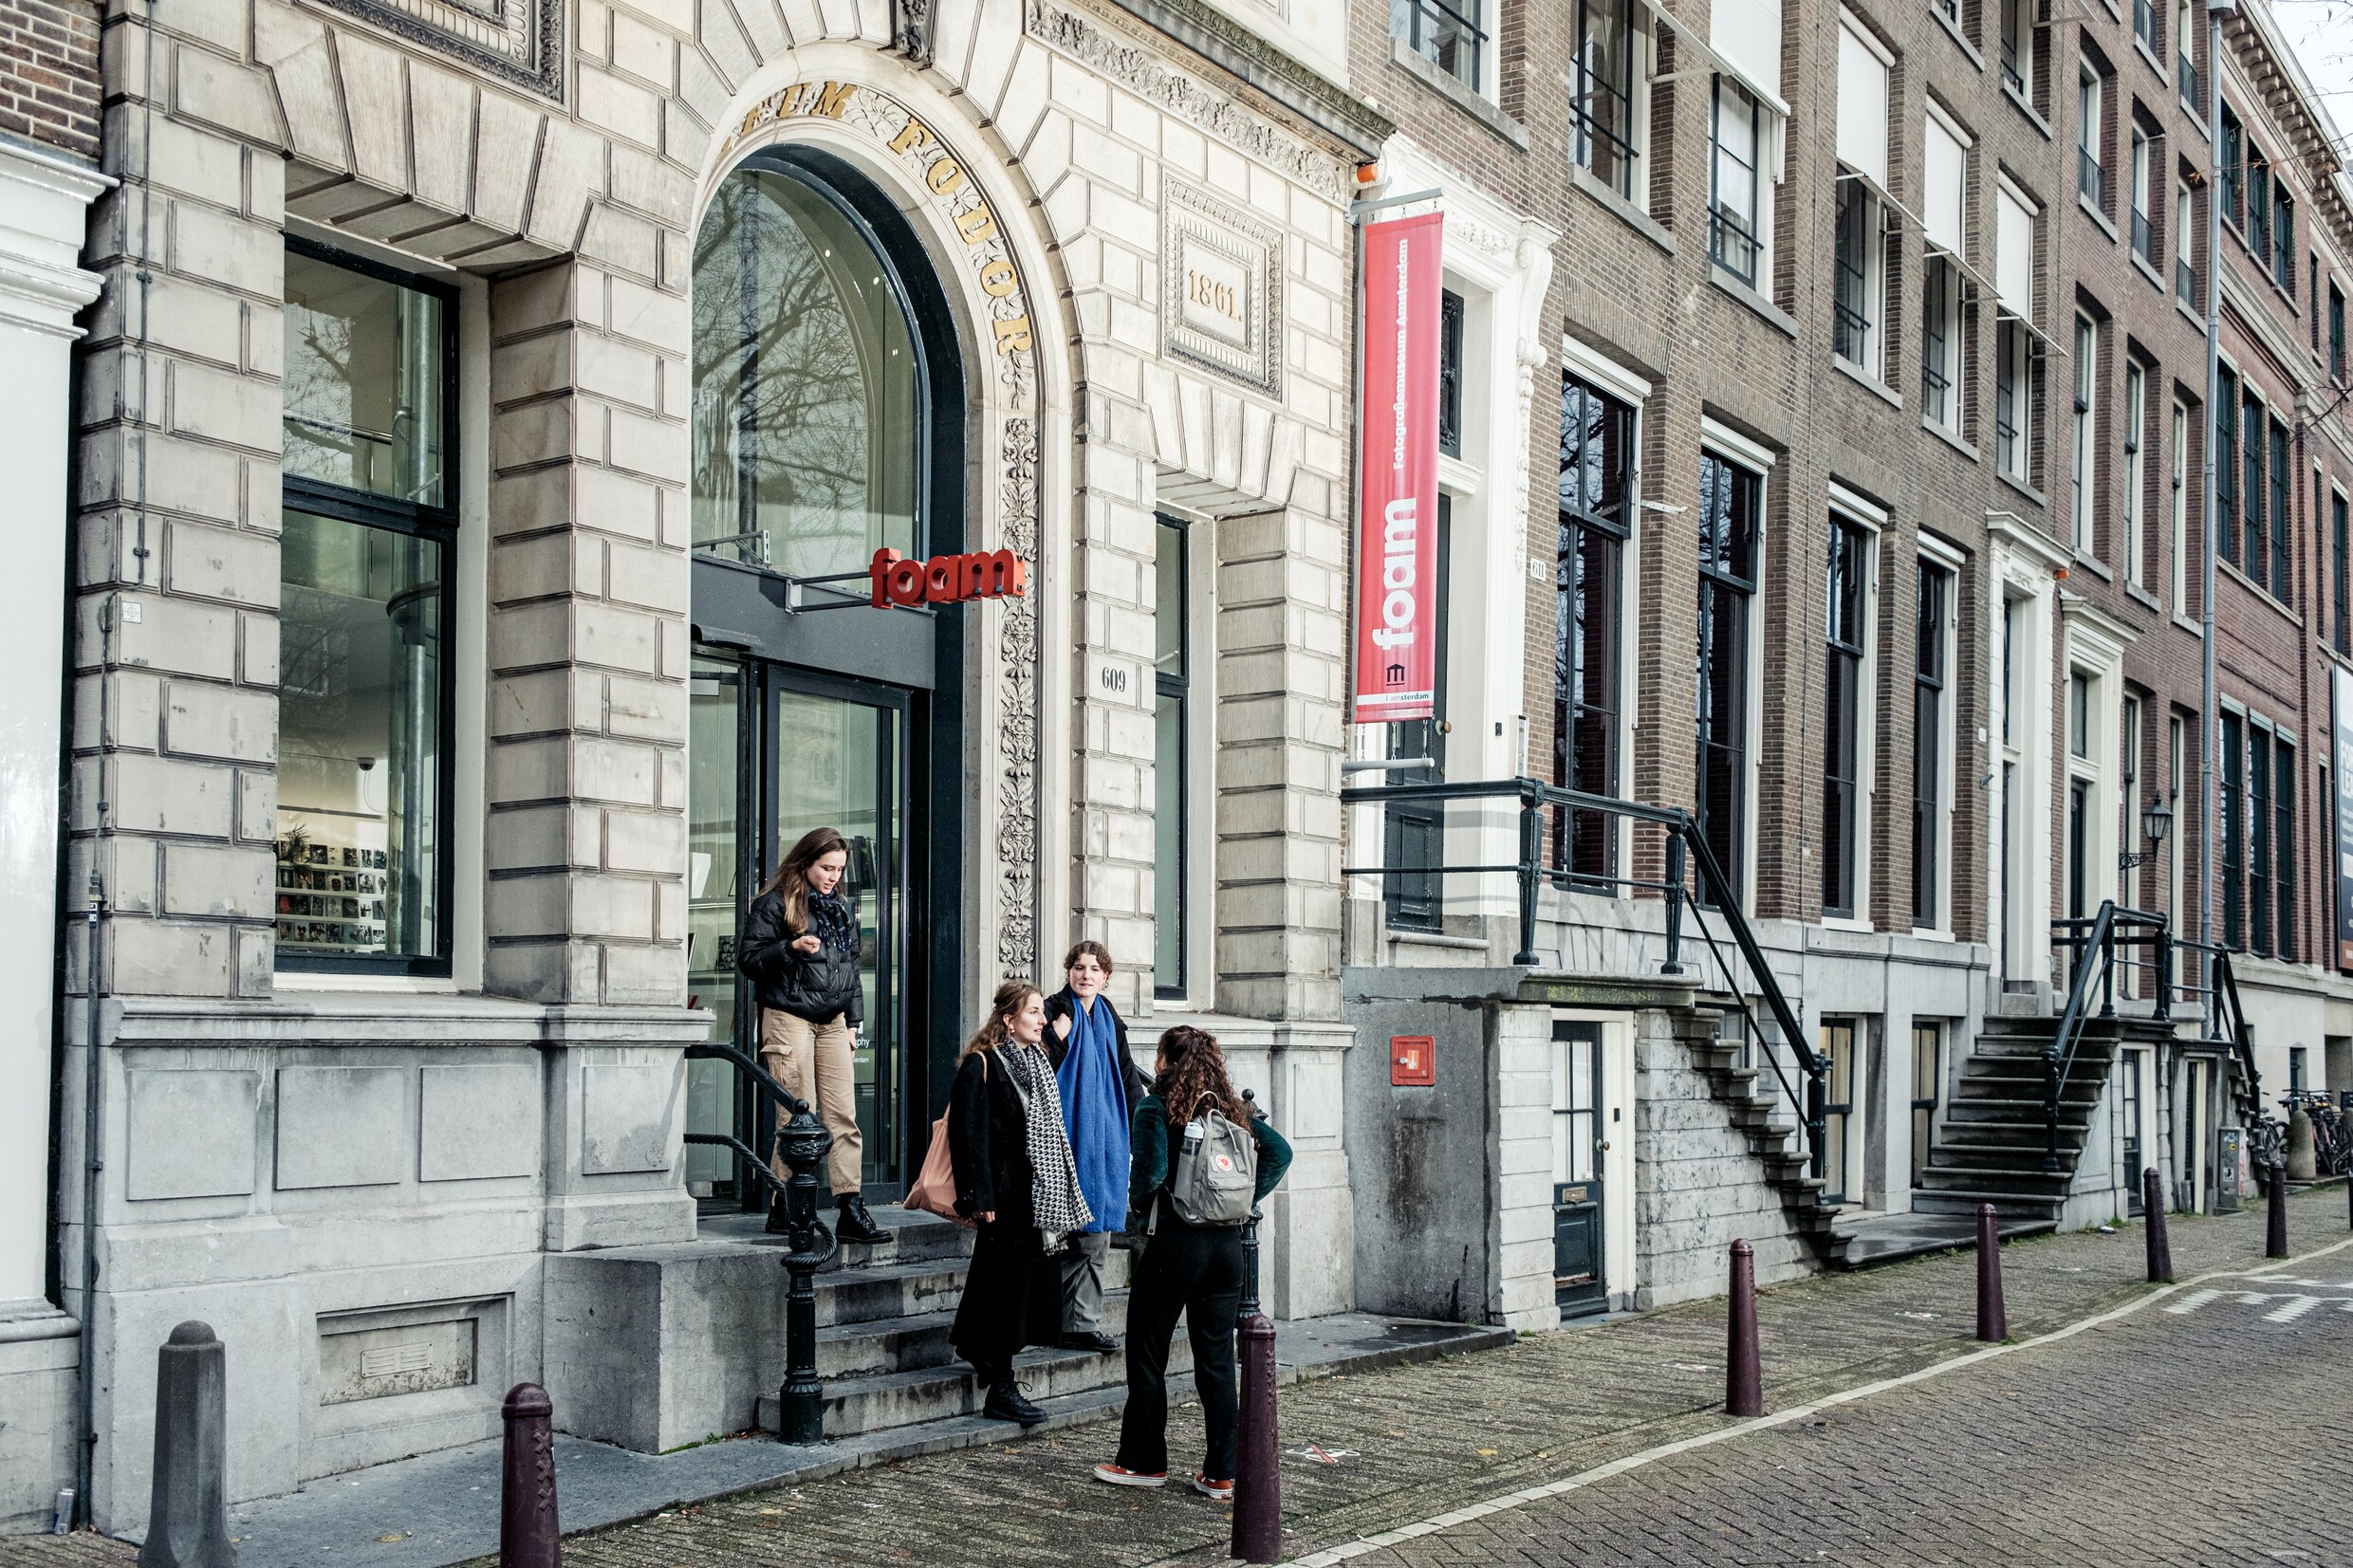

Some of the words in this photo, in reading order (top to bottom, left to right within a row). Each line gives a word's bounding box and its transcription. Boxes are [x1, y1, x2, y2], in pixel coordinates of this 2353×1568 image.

[886, 115, 1033, 357] FODOR
[1397, 238, 1409, 324] Amsterdam
[1393, 330, 1407, 470] Fotografiemuseum
[869, 547, 1026, 610] foam
[1372, 497, 1417, 651] foam
[1532, 561, 1545, 578] 611
[1102, 666, 1126, 692] 609
